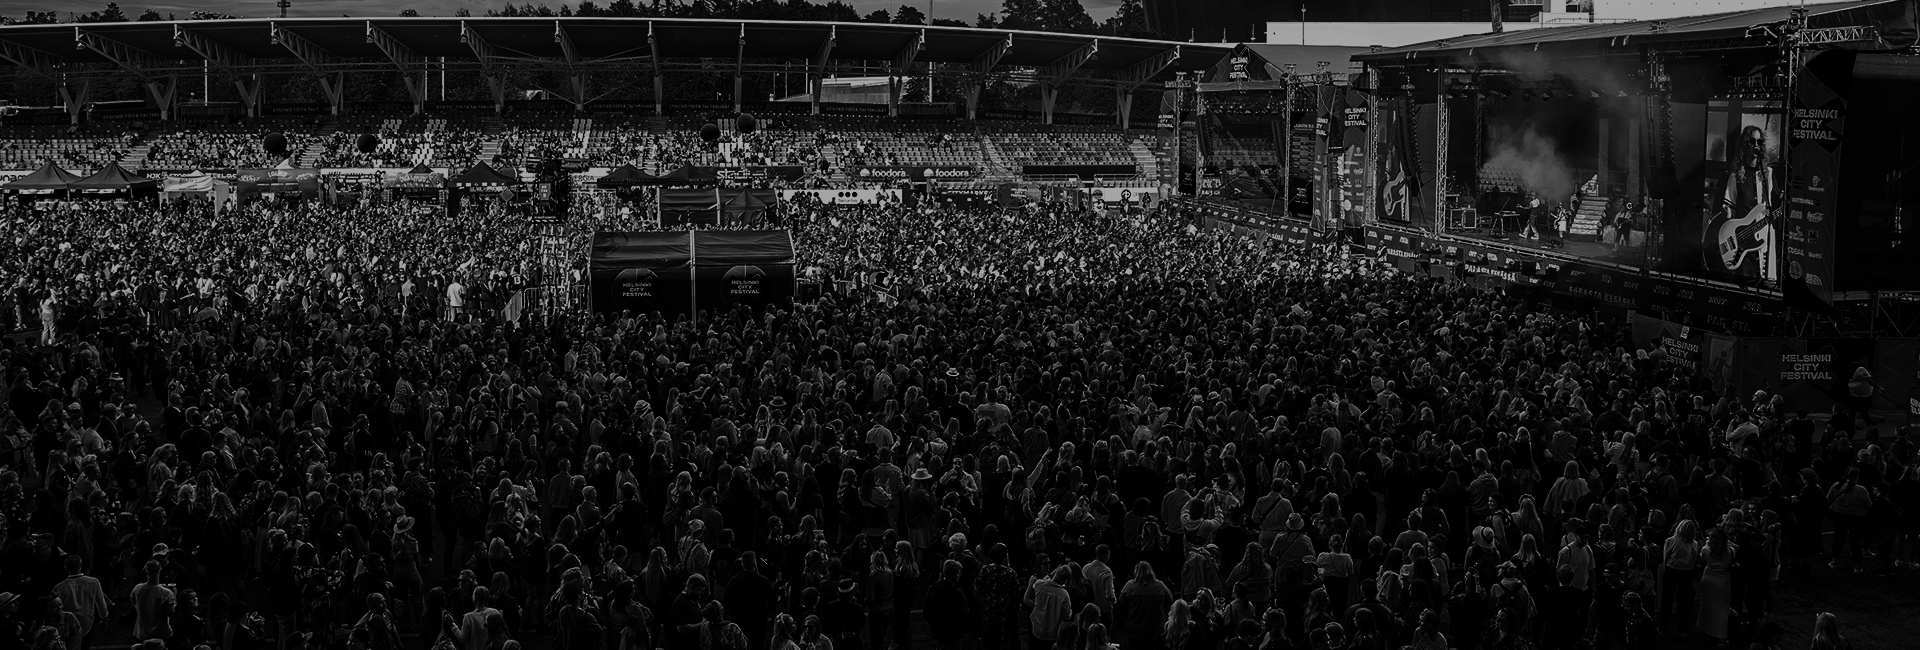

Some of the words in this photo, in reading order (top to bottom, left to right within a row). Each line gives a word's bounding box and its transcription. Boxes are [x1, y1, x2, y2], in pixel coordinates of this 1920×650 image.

[1795, 109, 1838, 118] HELSINKI
[1800, 119, 1823, 129] CITY
[1793, 129, 1837, 140] FESTIVAL
[872, 168, 906, 177] foodora
[935, 168, 969, 177] foodora
[1624, 280, 1640, 289] KOFF
[1708, 296, 1728, 306] KOFF
[1707, 314, 1751, 333] PARSTA
[1661, 336, 1699, 353] HELSINKI
[1669, 347, 1689, 359] CITY
[1782, 354, 1832, 362] HELSINKI
[1793, 363, 1819, 371] CITY
[1780, 372, 1832, 380] FESTIVAL
